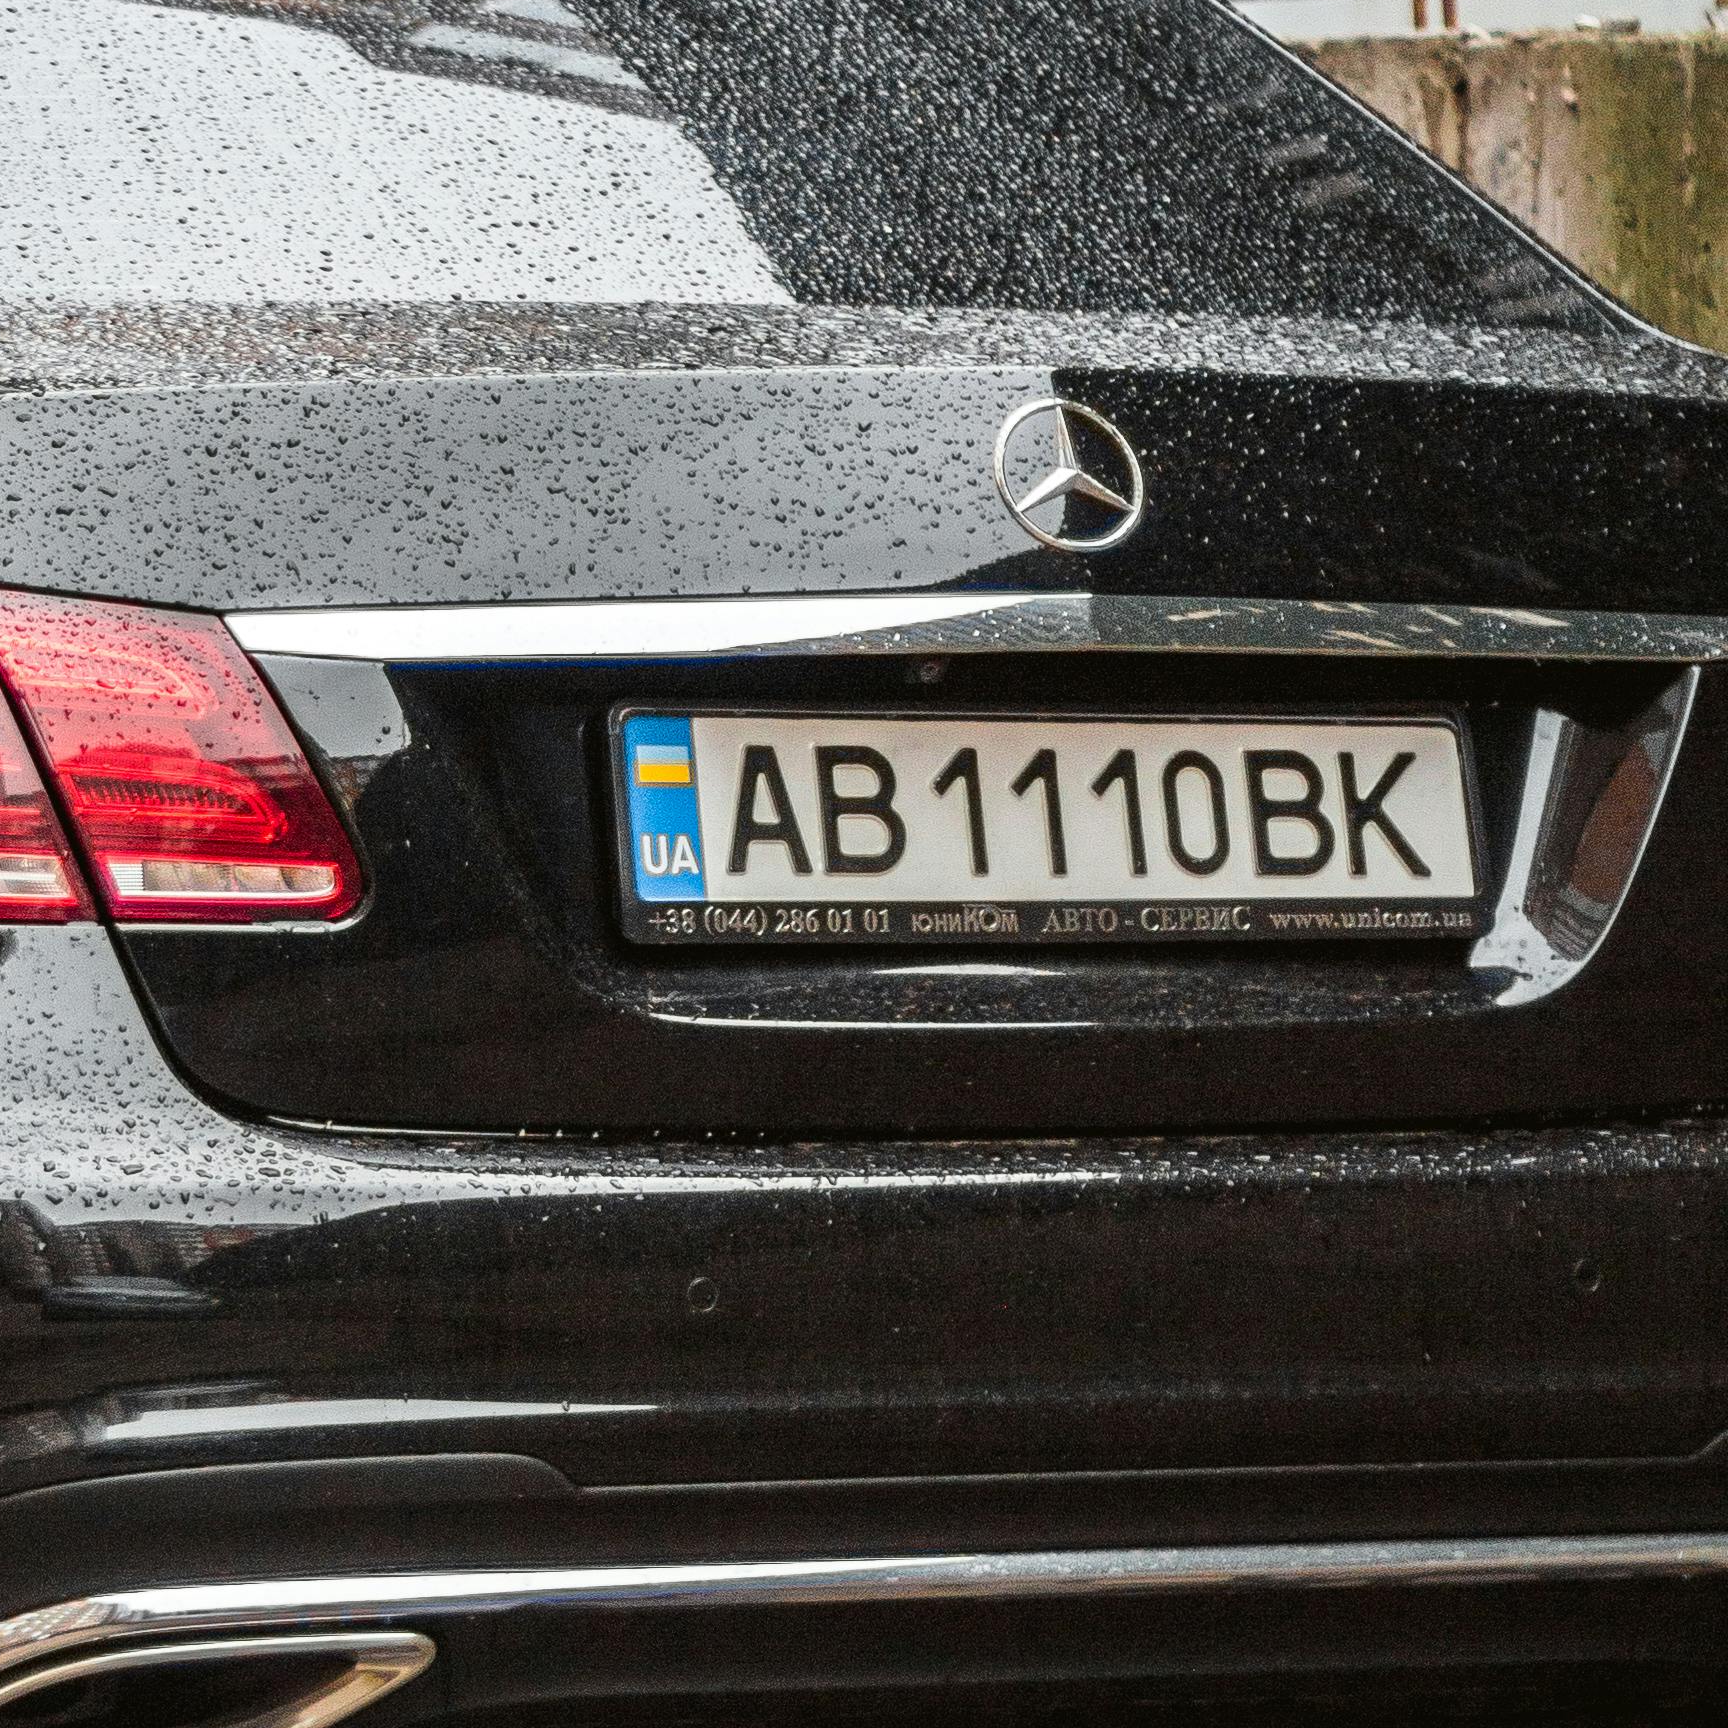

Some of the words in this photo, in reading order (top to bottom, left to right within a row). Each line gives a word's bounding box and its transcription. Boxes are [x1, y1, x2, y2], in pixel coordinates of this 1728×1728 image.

[641, 833, 700, 876] UA
[649, 908, 697, 934] +38
[704, 905, 768, 936] (044)
[775, 908, 821, 933] 286
[828, 908, 854, 933] 01
[864, 908, 891, 933] 01
[1141, 906, 1251, 932] СЕРВИС
[1270, 908, 1473, 928] www.unicom.ua
